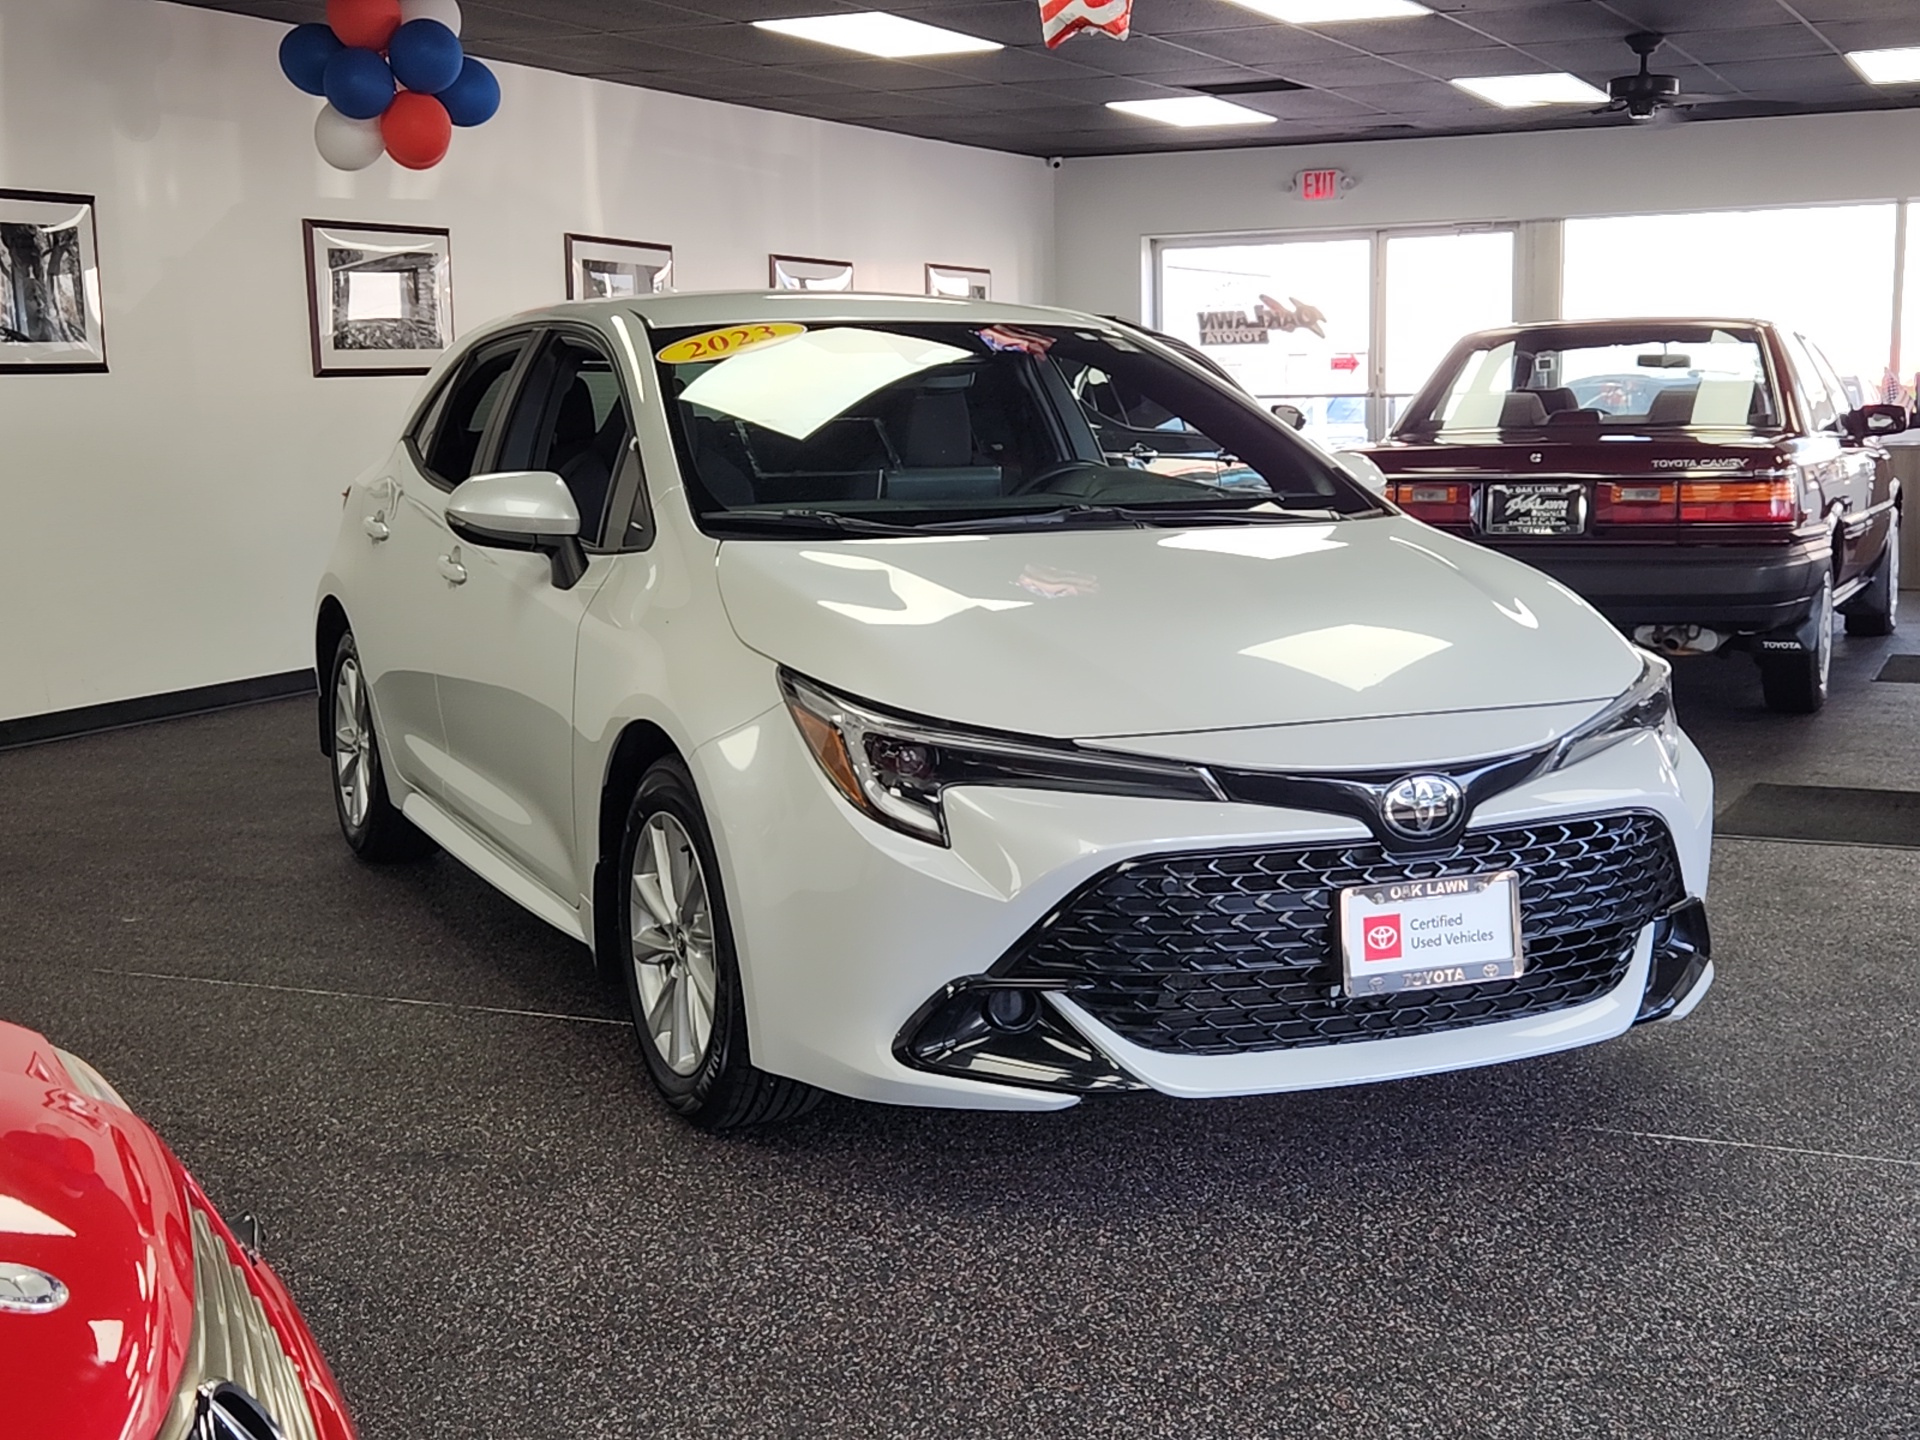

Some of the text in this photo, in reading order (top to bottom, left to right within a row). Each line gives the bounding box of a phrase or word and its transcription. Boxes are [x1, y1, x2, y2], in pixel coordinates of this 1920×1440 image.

[1304, 172, 1336, 199] EXIT
[684, 325, 776, 359] 2023
[1651, 458, 1750, 468] TOYOTA CAMRY
[1762, 641, 1801, 650] TOYOTA
[1390, 879, 1469, 900] OAK LAWN
[1410, 913, 1463, 931] Certified
[1411, 929, 1494, 950] Used Vehicles
[1402, 968, 1466, 986] TOYOTA
